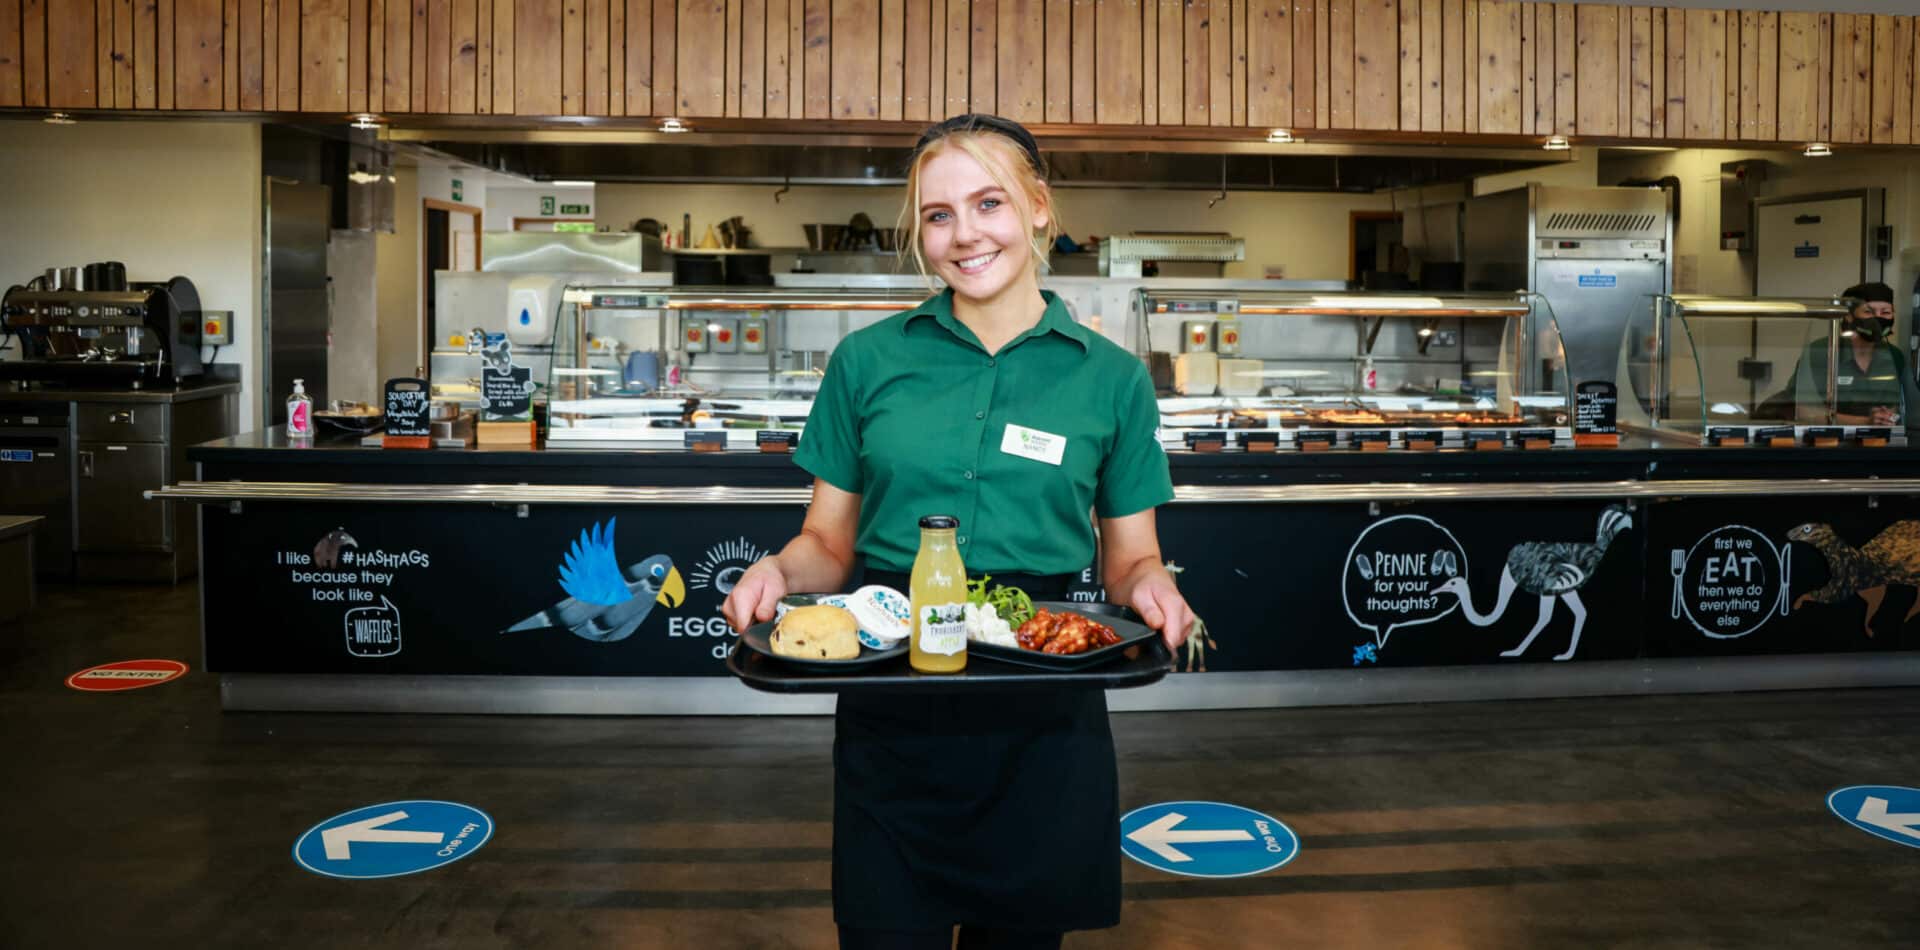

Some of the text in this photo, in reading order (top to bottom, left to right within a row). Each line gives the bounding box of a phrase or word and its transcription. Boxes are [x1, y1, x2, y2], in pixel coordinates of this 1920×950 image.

[402, 400, 417, 408] DAY
[1714, 537, 1753, 550] first we
[277, 549, 430, 568] I like #HASHTAGS
[1375, 550, 1427, 577] PENNE
[1706, 551, 1757, 583] EAT
[292, 570, 393, 586] because they
[312, 587, 374, 602] look like
[1374, 579, 1429, 596] for your
[1698, 584, 1763, 597] then we do
[1366, 595, 1439, 612] thoughts?
[1699, 598, 1760, 613] everything
[1717, 614, 1740, 627] else
[354, 619, 392, 644] WAFFLES
[437, 822, 480, 856] One way
[1254, 819, 1281, 852] One way
